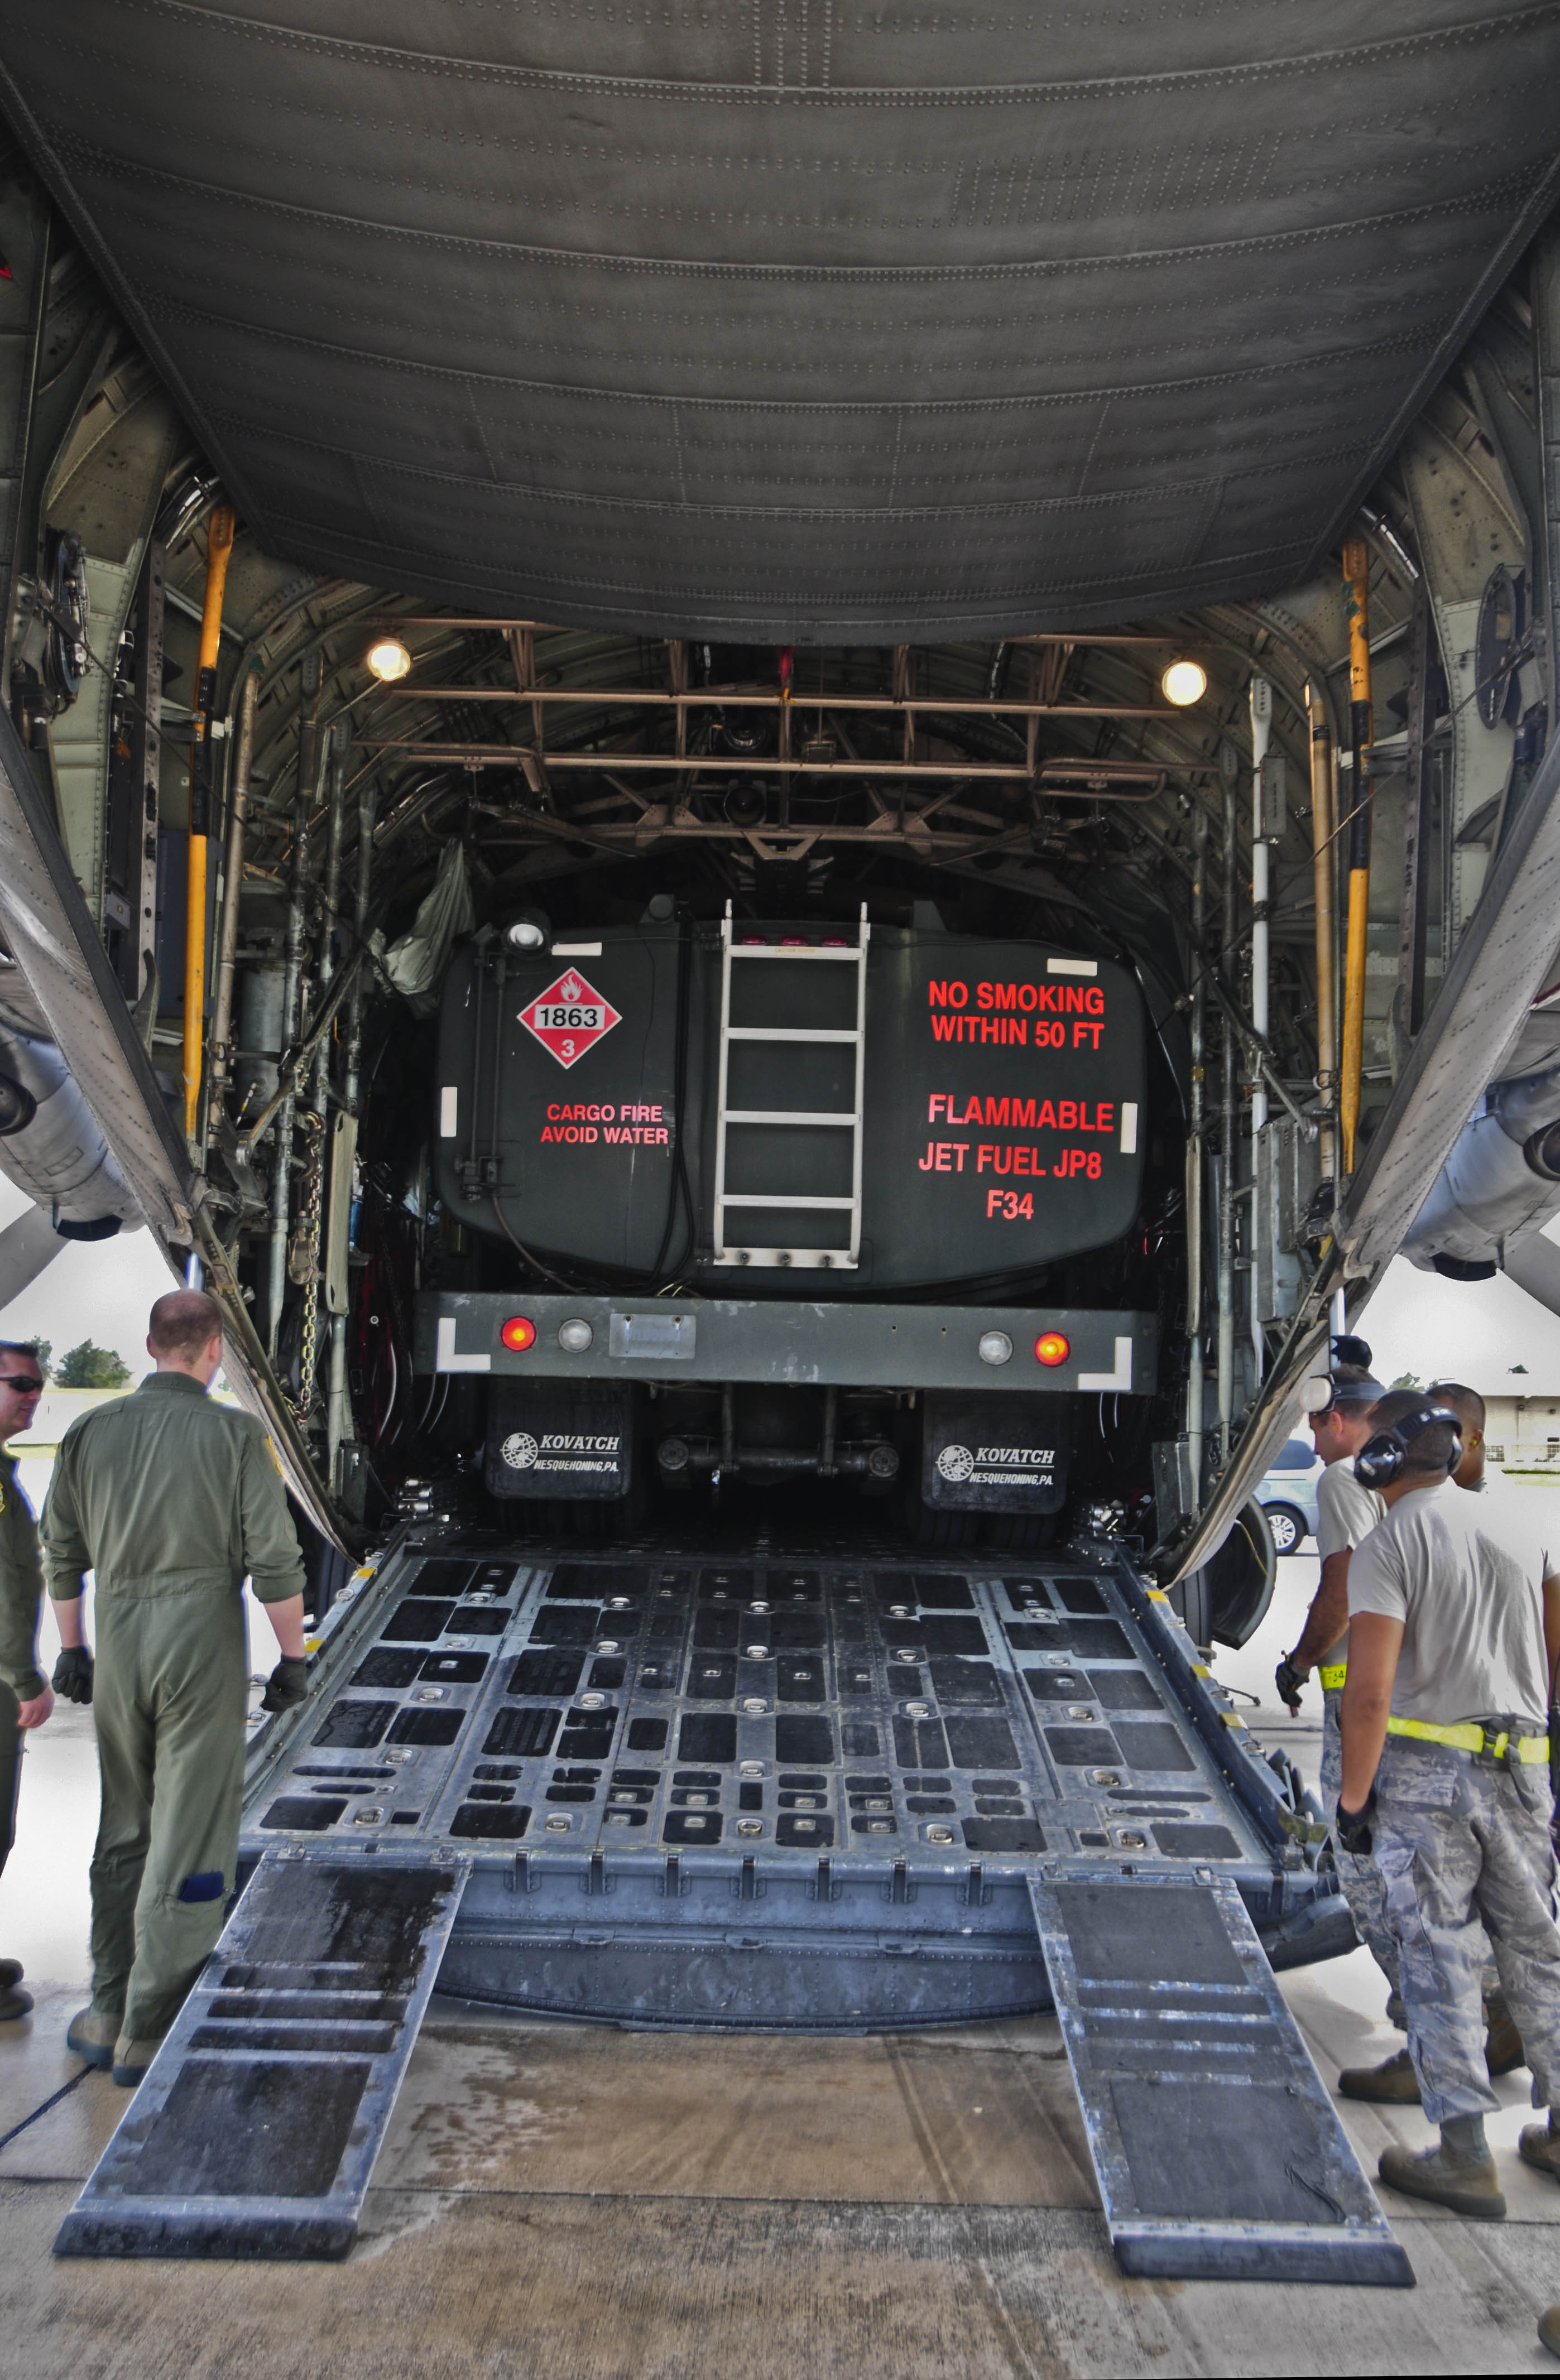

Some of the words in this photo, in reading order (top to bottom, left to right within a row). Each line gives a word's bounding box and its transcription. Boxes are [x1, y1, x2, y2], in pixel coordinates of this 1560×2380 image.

[928, 980, 968, 1009] NO
[976, 982, 1105, 1015] SMOKING
[540, 1008, 597, 1027] 1863
[930, 1014, 1027, 1045] WITHIN
[1035, 1020, 1065, 1049] 50
[1073, 1021, 1105, 1050] FT
[561, 1039, 575, 1057] 3
[546, 1103, 615, 1123] CARGO
[620, 1104, 663, 1123] FIRE
[928, 1094, 1115, 1132] FLAMMABLE
[540, 1125, 598, 1143] AVOID
[603, 1126, 669, 1145] WATER
[918, 1142, 970, 1171] JET
[977, 1144, 1047, 1176] FUEL
[1053, 1149, 1102, 1179] JP8
[987, 1189, 1034, 1219] F34
[539, 1435, 620, 1451] KOVATCH
[975, 1448, 1055, 1464] KOVATCH
